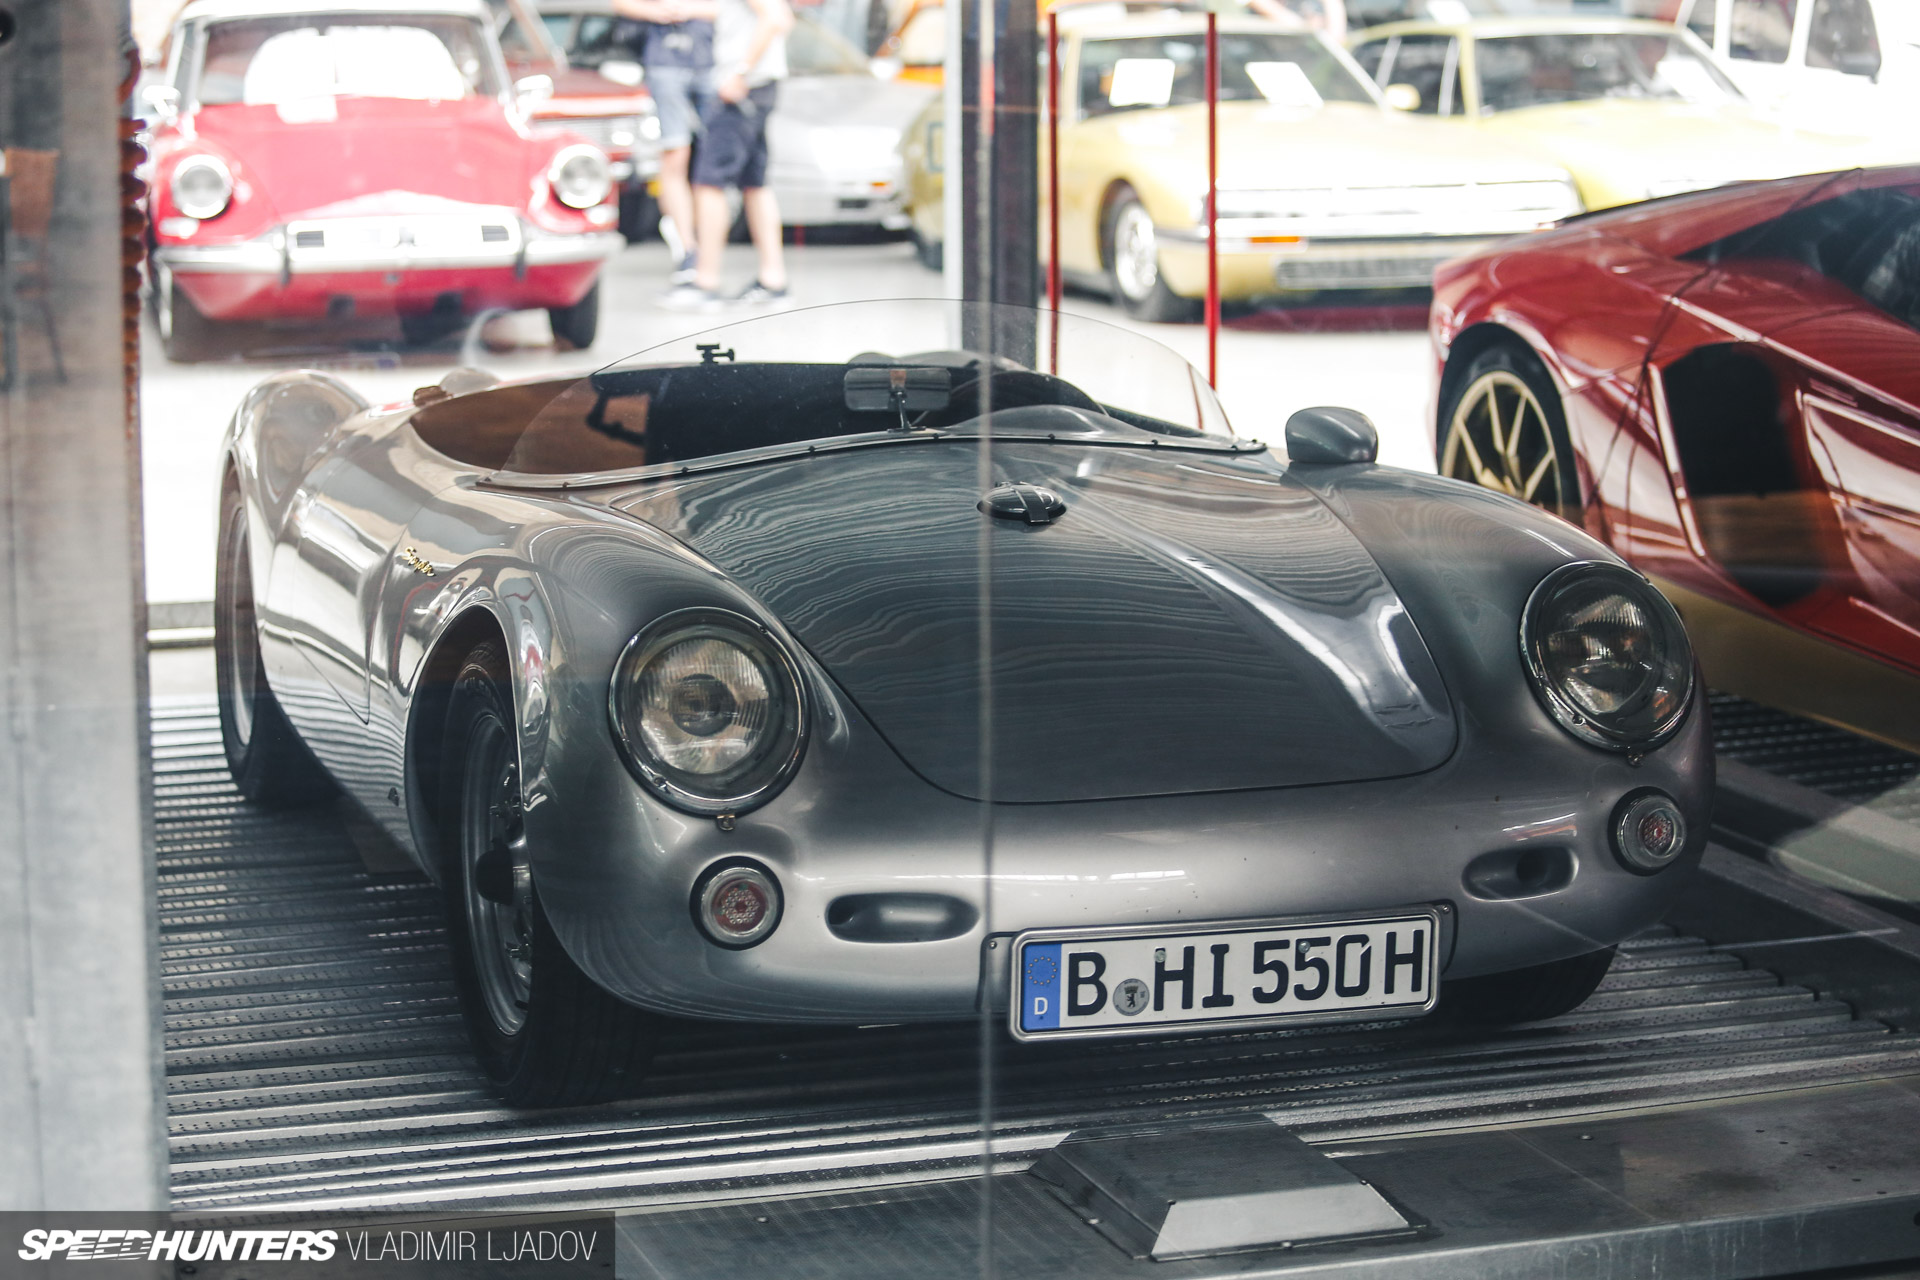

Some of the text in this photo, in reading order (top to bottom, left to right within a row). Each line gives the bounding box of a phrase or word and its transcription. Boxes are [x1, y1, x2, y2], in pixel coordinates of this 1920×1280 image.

[1067, 952, 1108, 1017] B
[1154, 945, 1235, 1012] HI
[1034, 996, 1049, 1016] D
